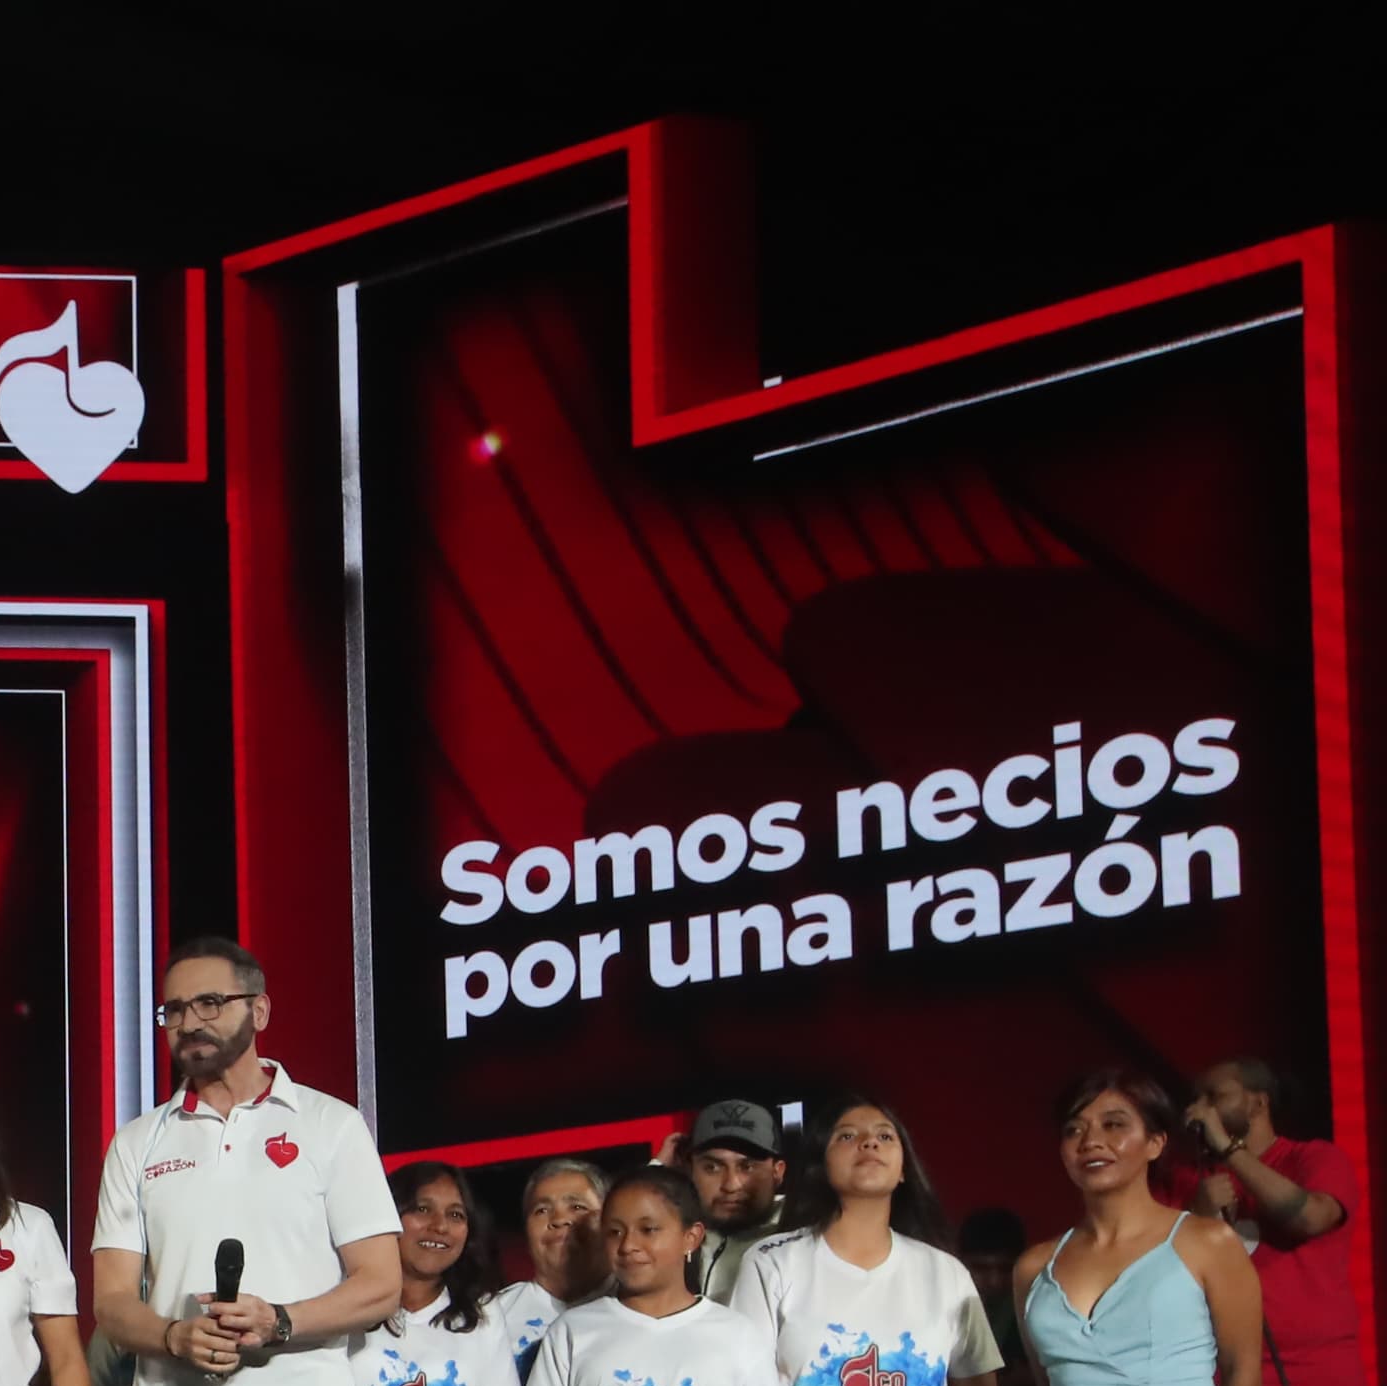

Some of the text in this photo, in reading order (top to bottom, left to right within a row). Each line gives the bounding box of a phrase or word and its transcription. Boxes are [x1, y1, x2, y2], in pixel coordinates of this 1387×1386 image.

[439, 718, 1240, 925] Somos necios
[444, 814, 1241, 1039] por una razón
